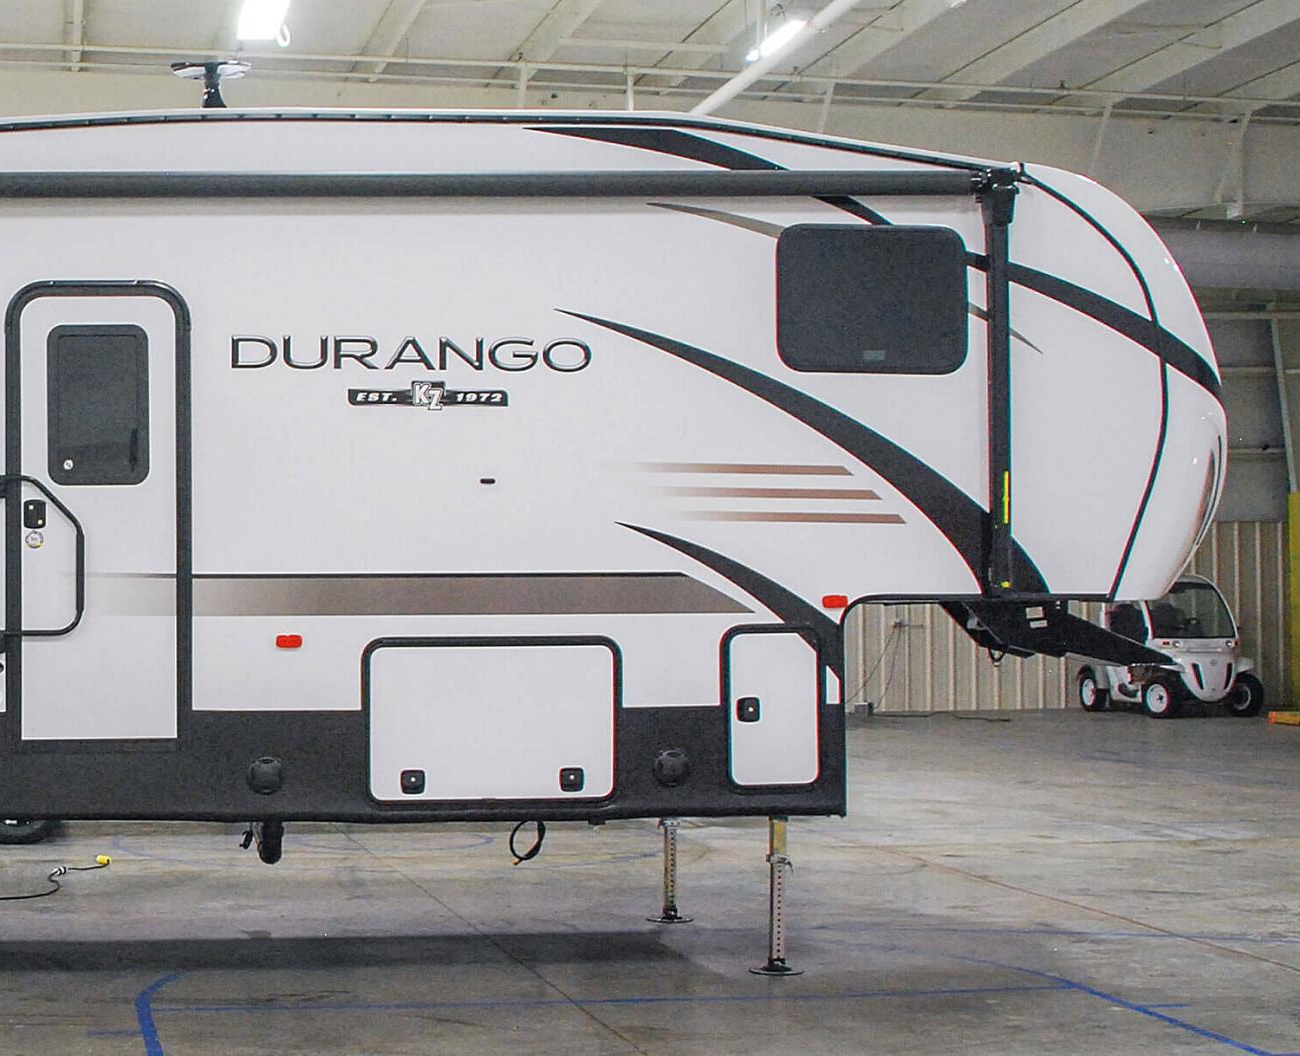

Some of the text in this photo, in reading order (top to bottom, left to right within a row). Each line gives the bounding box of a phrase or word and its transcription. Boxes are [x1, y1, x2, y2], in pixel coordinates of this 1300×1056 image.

[230, 335, 592, 372] DURANGO
[355, 382, 503, 411] EST. KZ 1972
